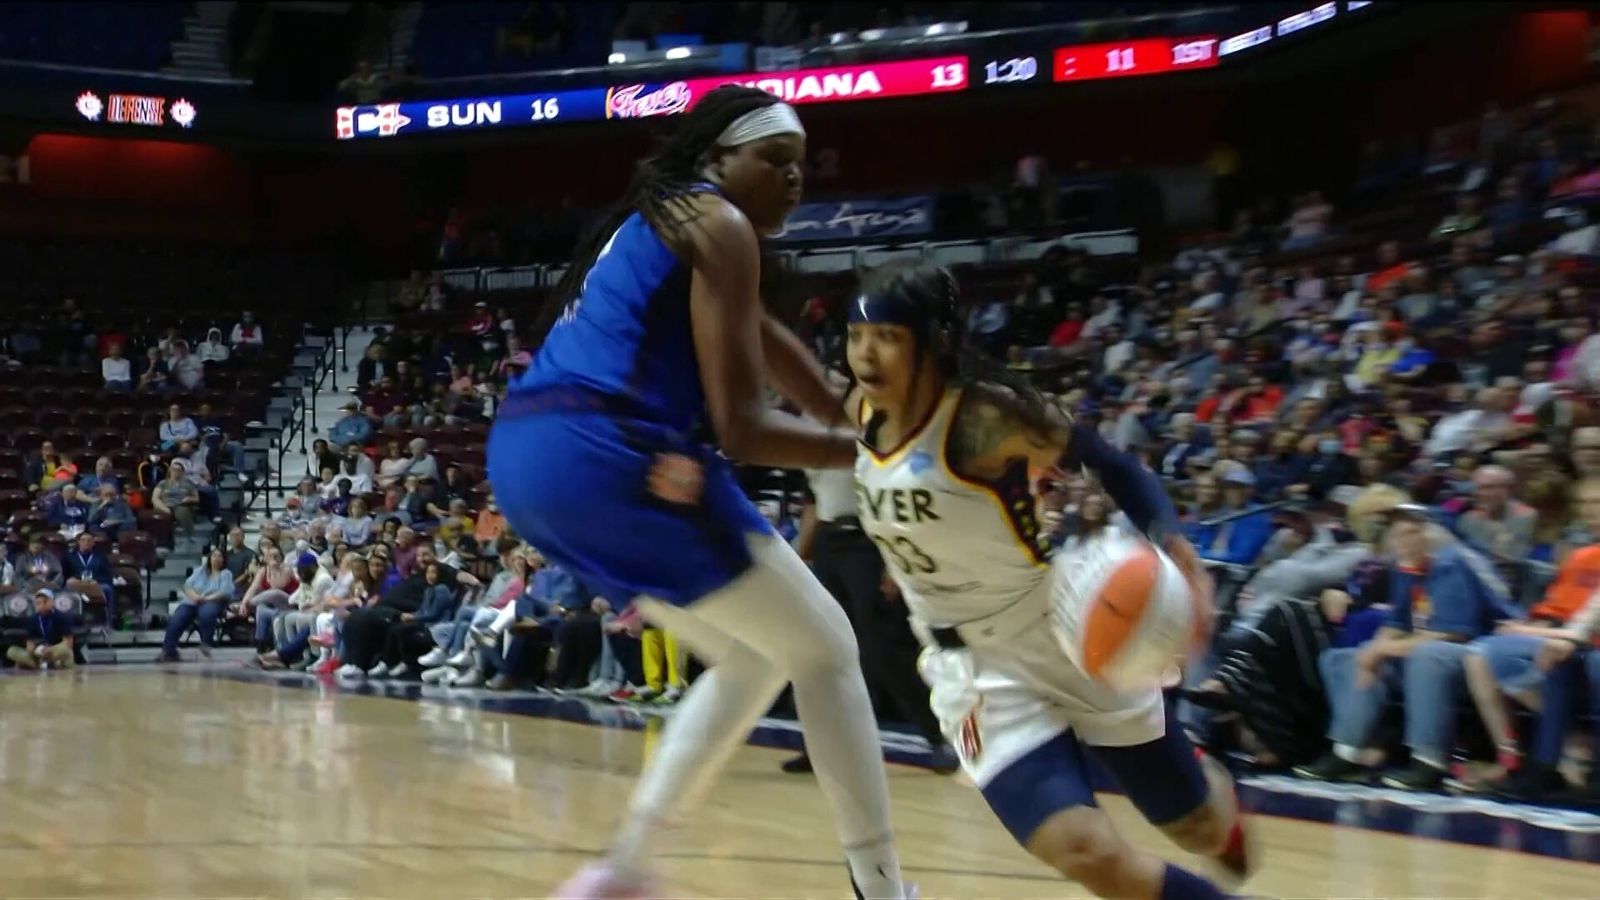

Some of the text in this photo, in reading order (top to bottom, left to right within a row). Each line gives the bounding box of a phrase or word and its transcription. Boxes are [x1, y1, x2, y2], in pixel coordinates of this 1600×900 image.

[732, 70, 883, 101] DIANA
[930, 63, 964, 87] 13
[427, 97, 559, 128] SUN 16
